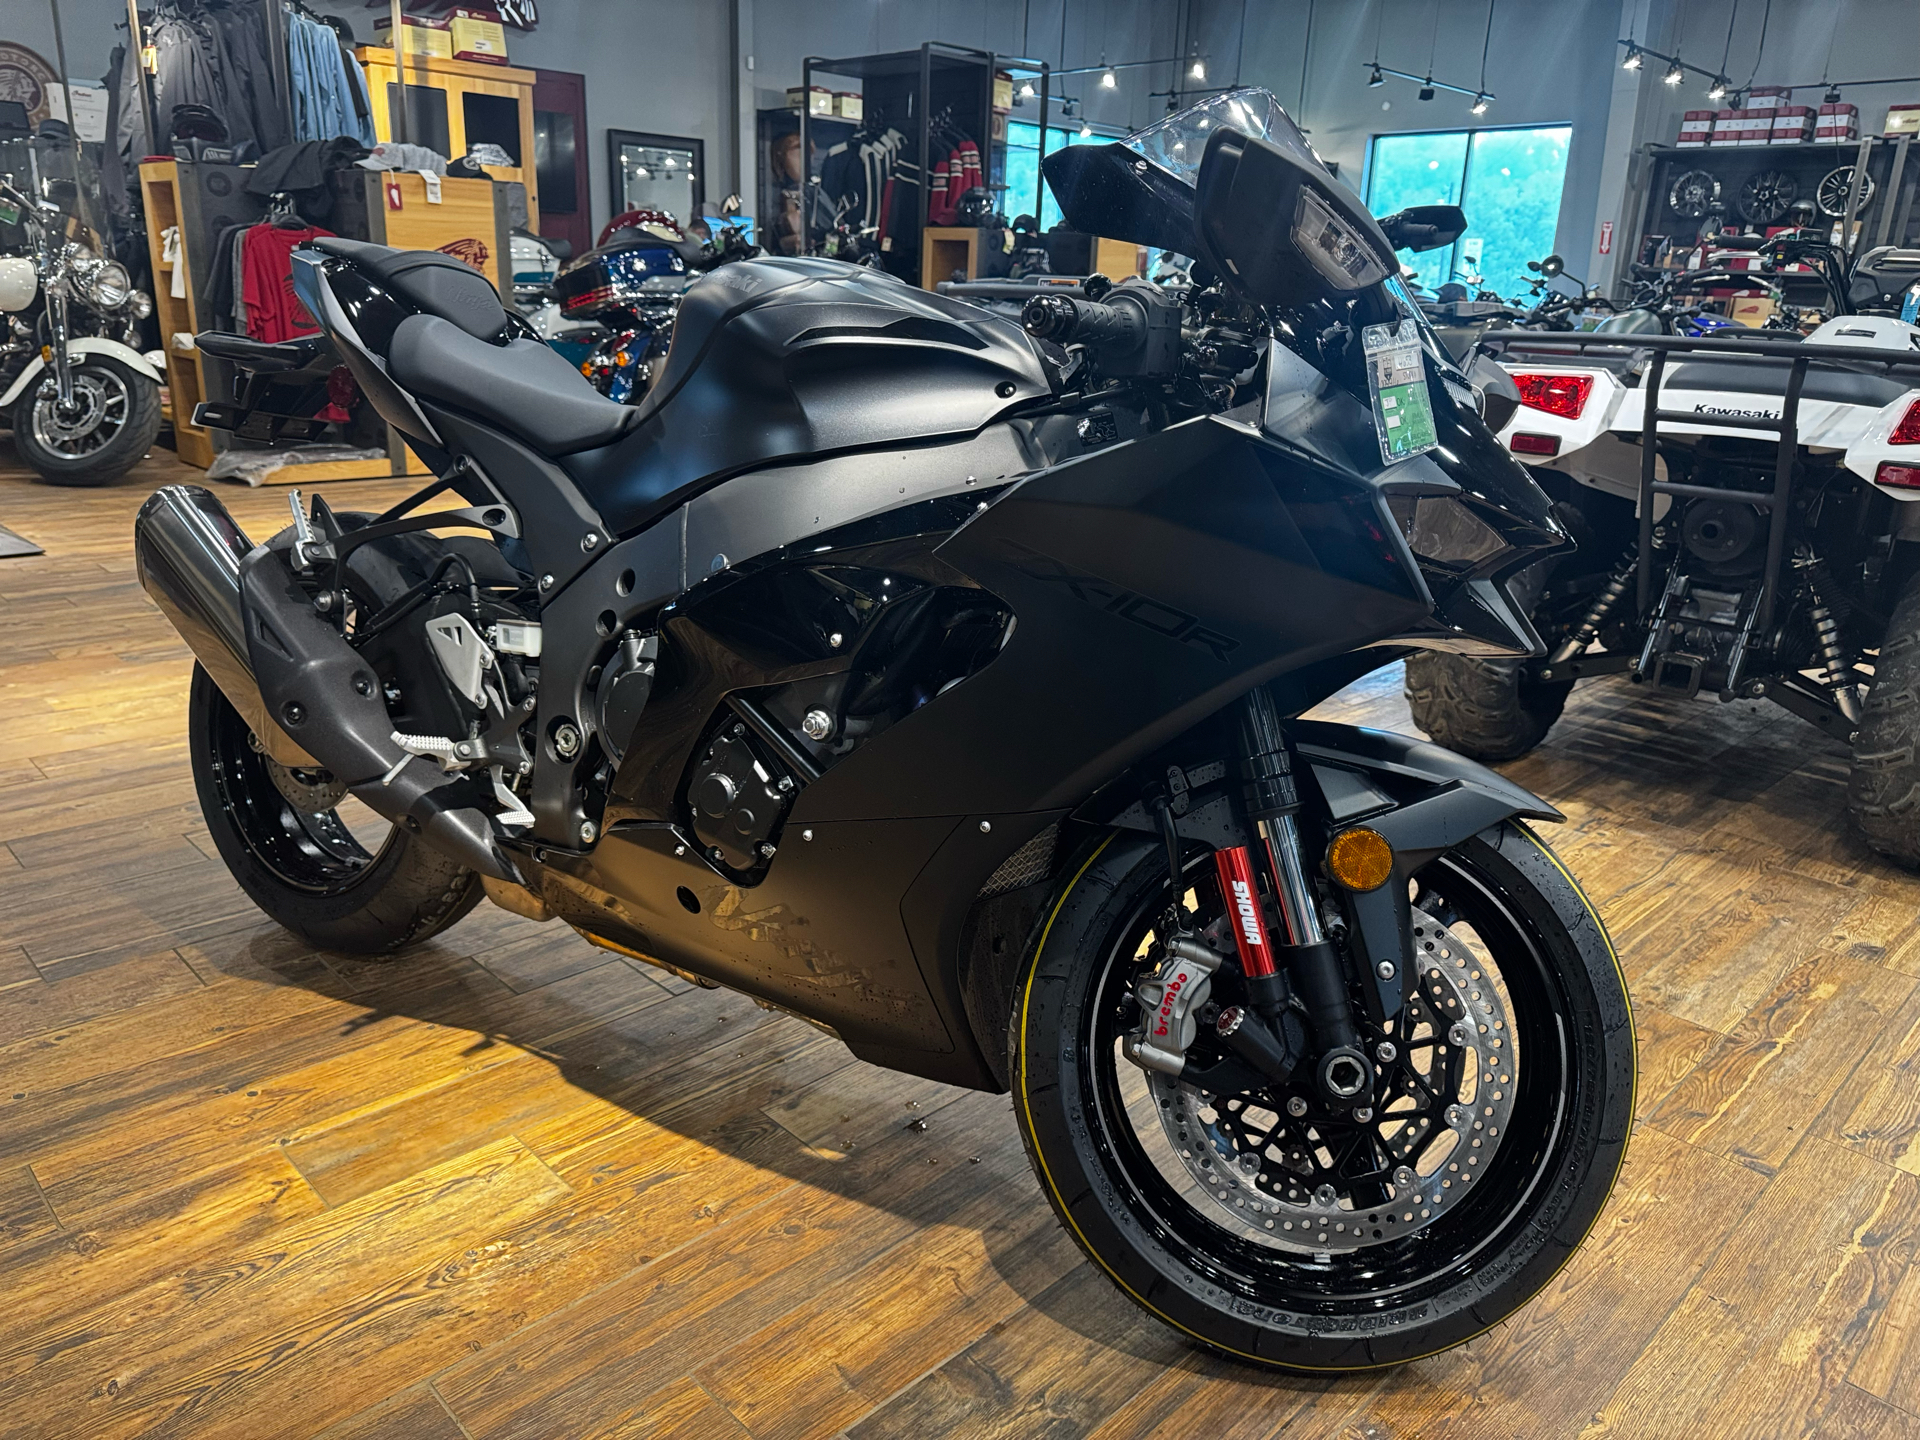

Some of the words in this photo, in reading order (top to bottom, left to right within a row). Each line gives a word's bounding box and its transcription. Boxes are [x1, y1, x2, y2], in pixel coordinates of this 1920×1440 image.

[1694, 403, 1780, 420] Kawasaki
[1231, 880, 1262, 945] SHOWA
[1154, 973, 1188, 1036] brembo
